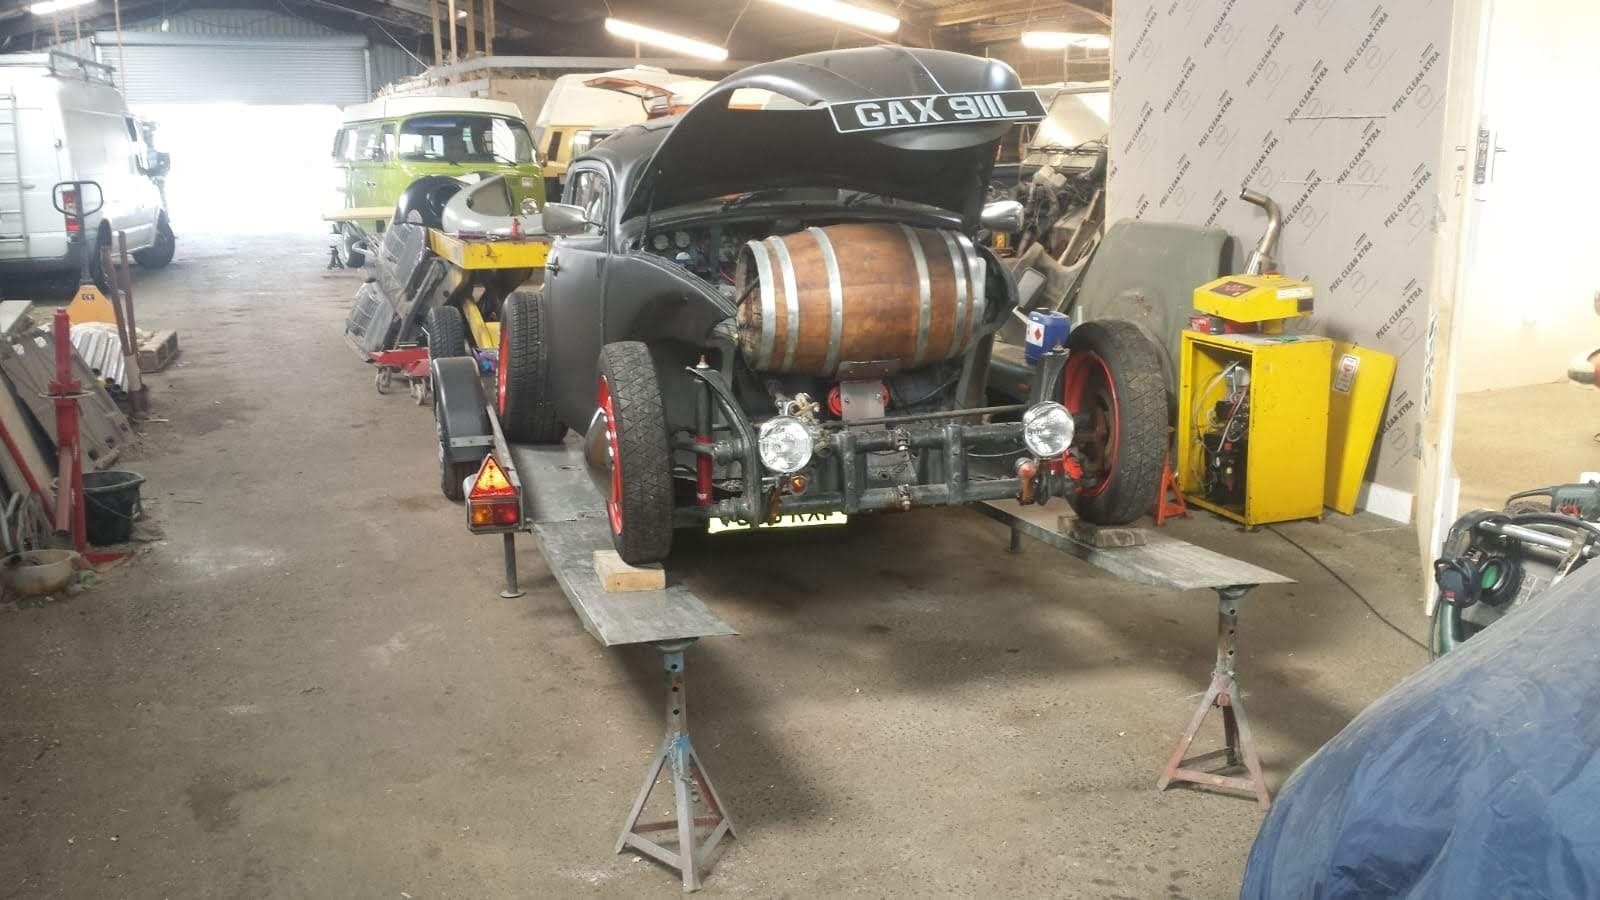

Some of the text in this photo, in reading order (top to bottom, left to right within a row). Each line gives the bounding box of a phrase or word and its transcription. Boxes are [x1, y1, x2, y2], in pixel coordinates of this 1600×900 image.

[1204, 32, 1214, 48] PEEL
[1213, 11, 1228, 32] CLEAN
[1344, 56, 1358, 74] PEEL
[1356, 32, 1374, 56] CLEAN
[1372, 12, 1389, 34] XTRA
[1246, 71, 1258, 88] PEEL
[1256, 48, 1272, 71] CLEAN
[1270, 31, 1285, 50] XTRA
[1172, 79, 1186, 100] CLEAN
[1184, 62, 1196, 80] XTRA
[1298, 84, 1316, 108] CLEAN
[1313, 66, 1328, 86] XTRA
[1392, 95, 1408, 112] PEEL
[1405, 71, 1425, 96] CLEAN
[1423, 51, 1440, 72] XTRA
[854, 94, 1027, 127] GAX 911L
[1207, 114, 1222, 134] CLEAN
[1220, 96, 1234, 114] XTRA
[1250, 154, 1266, 176] CLEAN
[1264, 137, 1279, 156] XTRA
[1337, 168, 1350, 184] PEEL
[1349, 146, 1366, 170] CLEAN
[1364, 128, 1381, 148] XTRA
[1168, 176, 1181, 194] CLEAN
[1179, 160, 1191, 177] XTRA
[1292, 193, 1309, 214] CLEAN
[1306, 176, 1322, 194] XTRA
[1216, 196, 1228, 214] XTRA
[1384, 211, 1398, 228] PEEL
[1397, 188, 1416, 212] CLEAN
[1414, 170, 1432, 192] XTRA
[1329, 277, 1344, 294] PEEL
[1342, 256, 1359, 278] CLEAN
[1357, 241, 1373, 260] XTRA
[1376, 323, 1390, 340] PEEL
[1388, 304, 1408, 324] CLEAN
[1406, 287, 1424, 306] XTRA
[1398, 399, 1415, 416] XTRA
